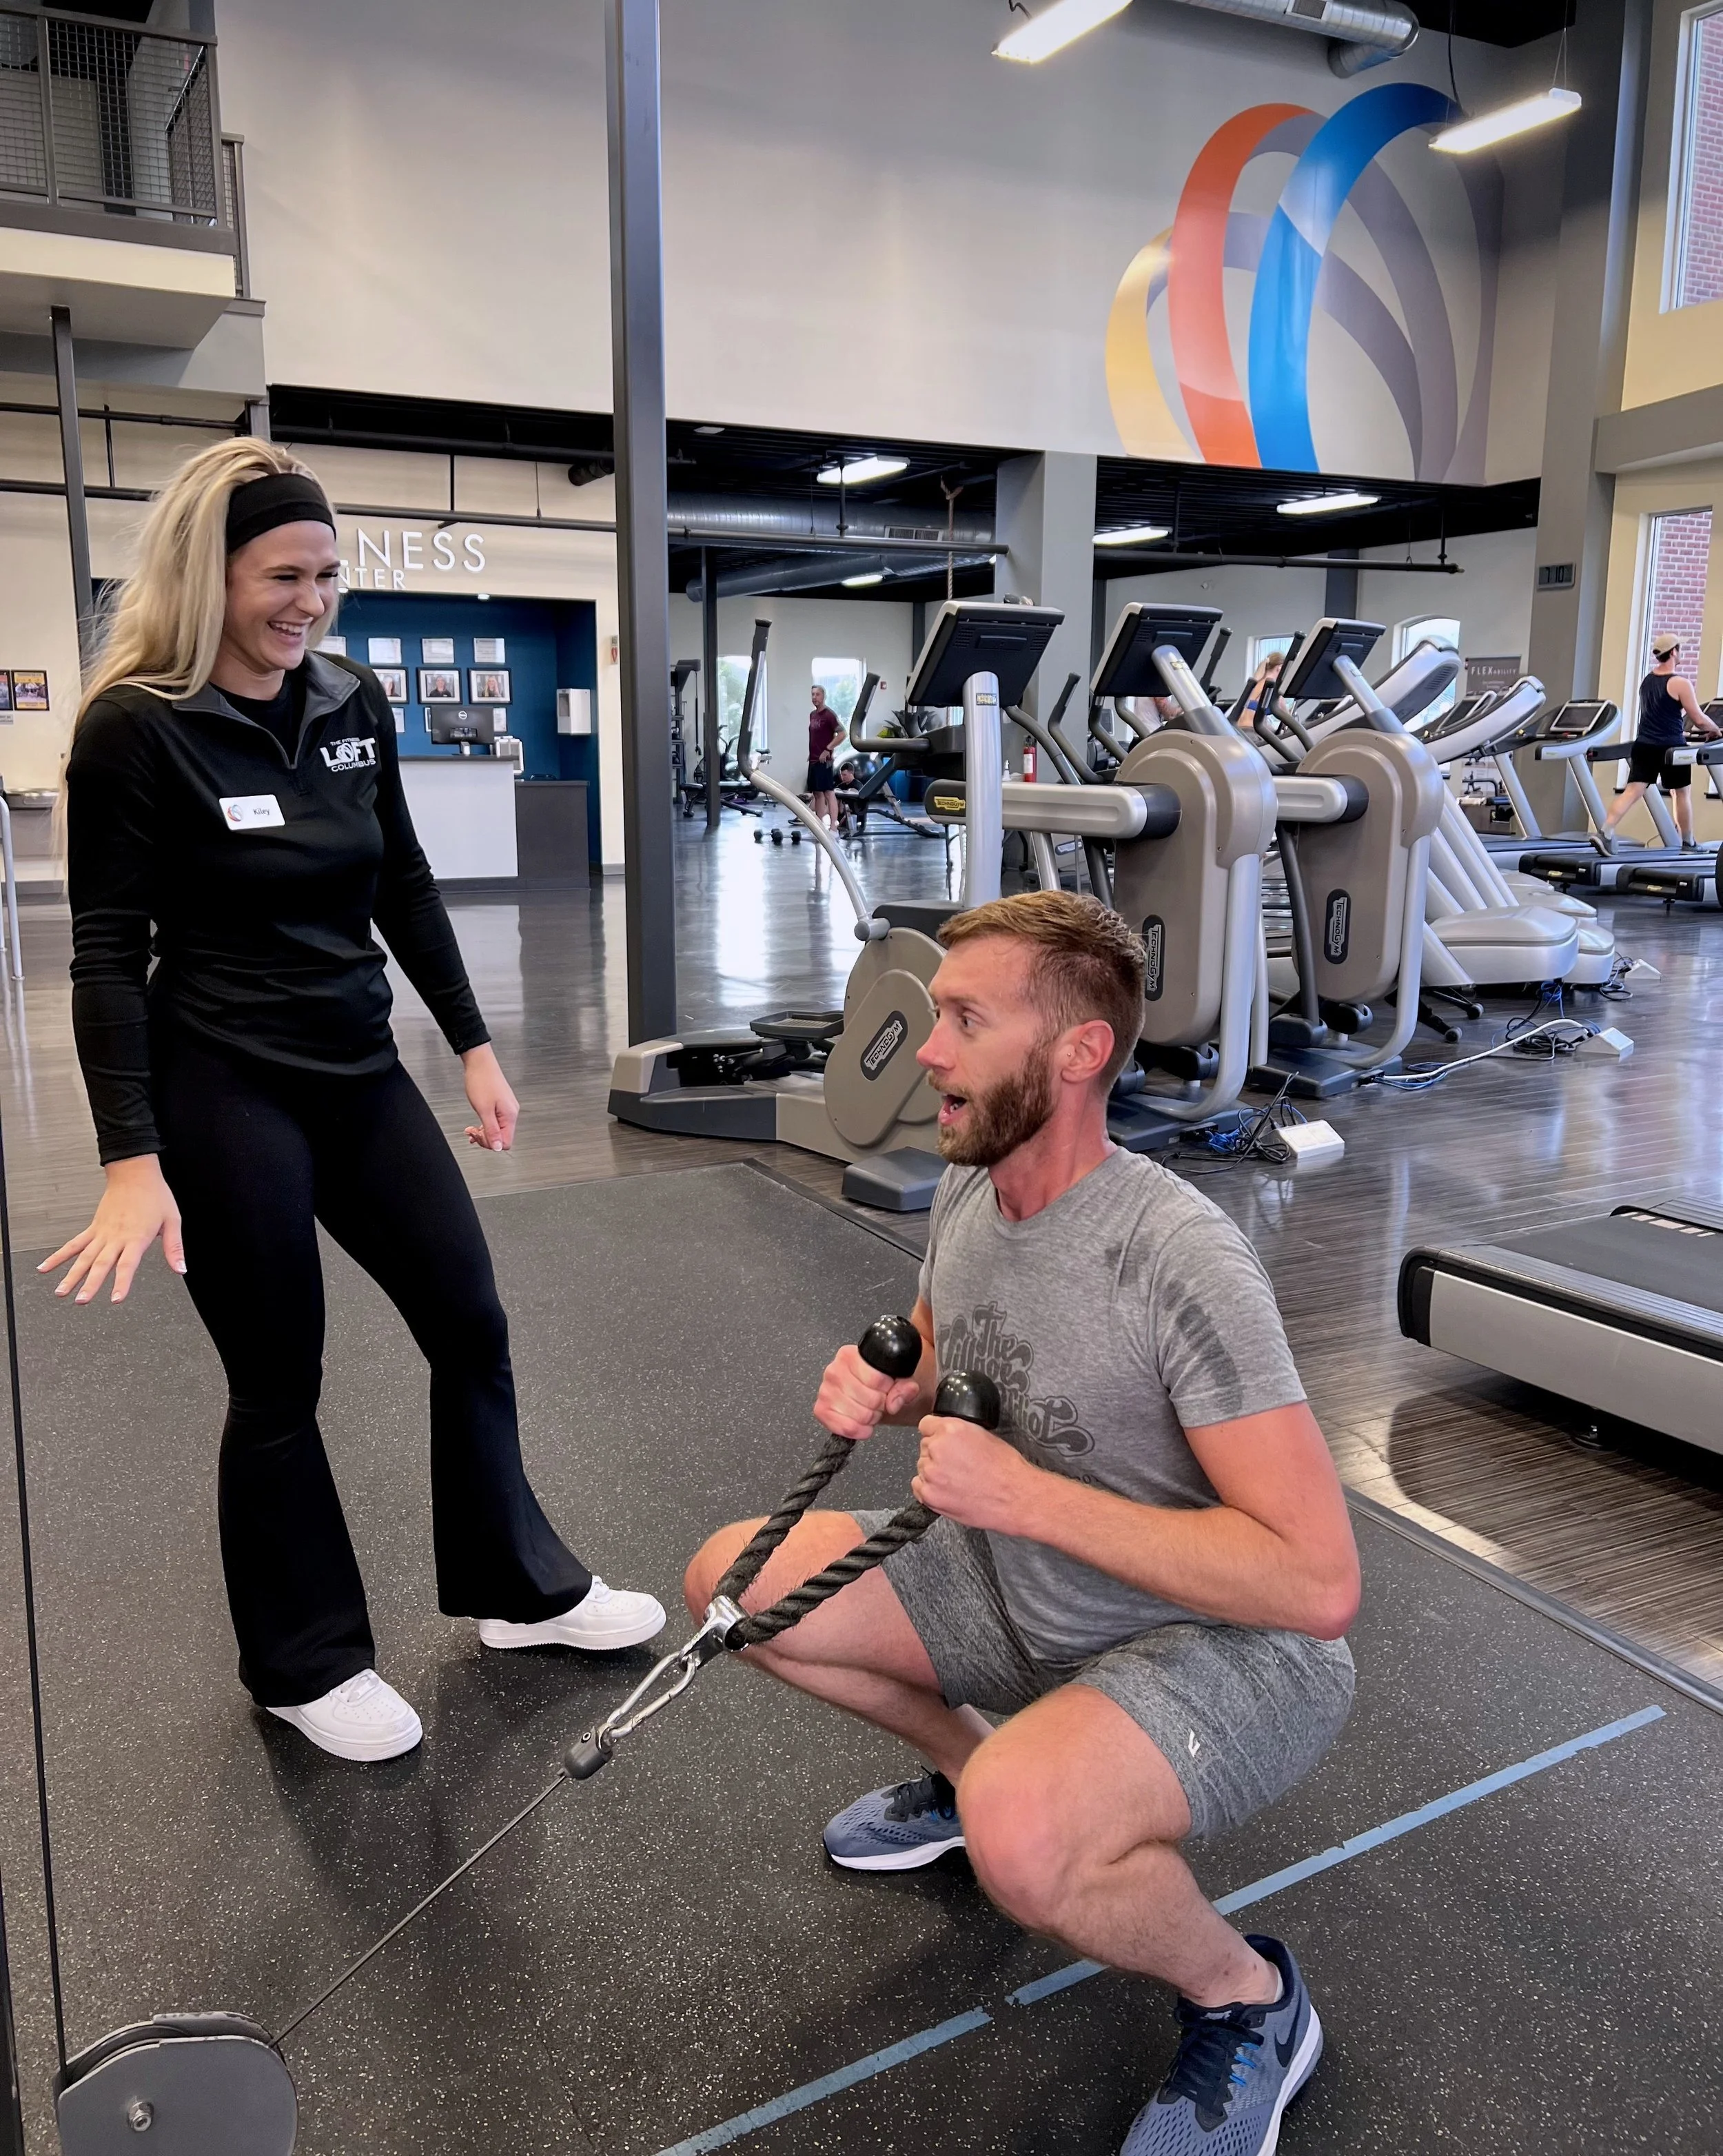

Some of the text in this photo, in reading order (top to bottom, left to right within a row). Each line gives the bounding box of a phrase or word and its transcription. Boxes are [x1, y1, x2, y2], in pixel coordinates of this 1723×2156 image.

[340, 527, 486, 572] NESS
[331, 758, 376, 772] COLUMBUS
[1332, 897, 1345, 954] TECHNOGYM
[1148, 926, 1160, 989] TECHNOGYM
[866, 1023, 901, 1066] TECHNOGYM
